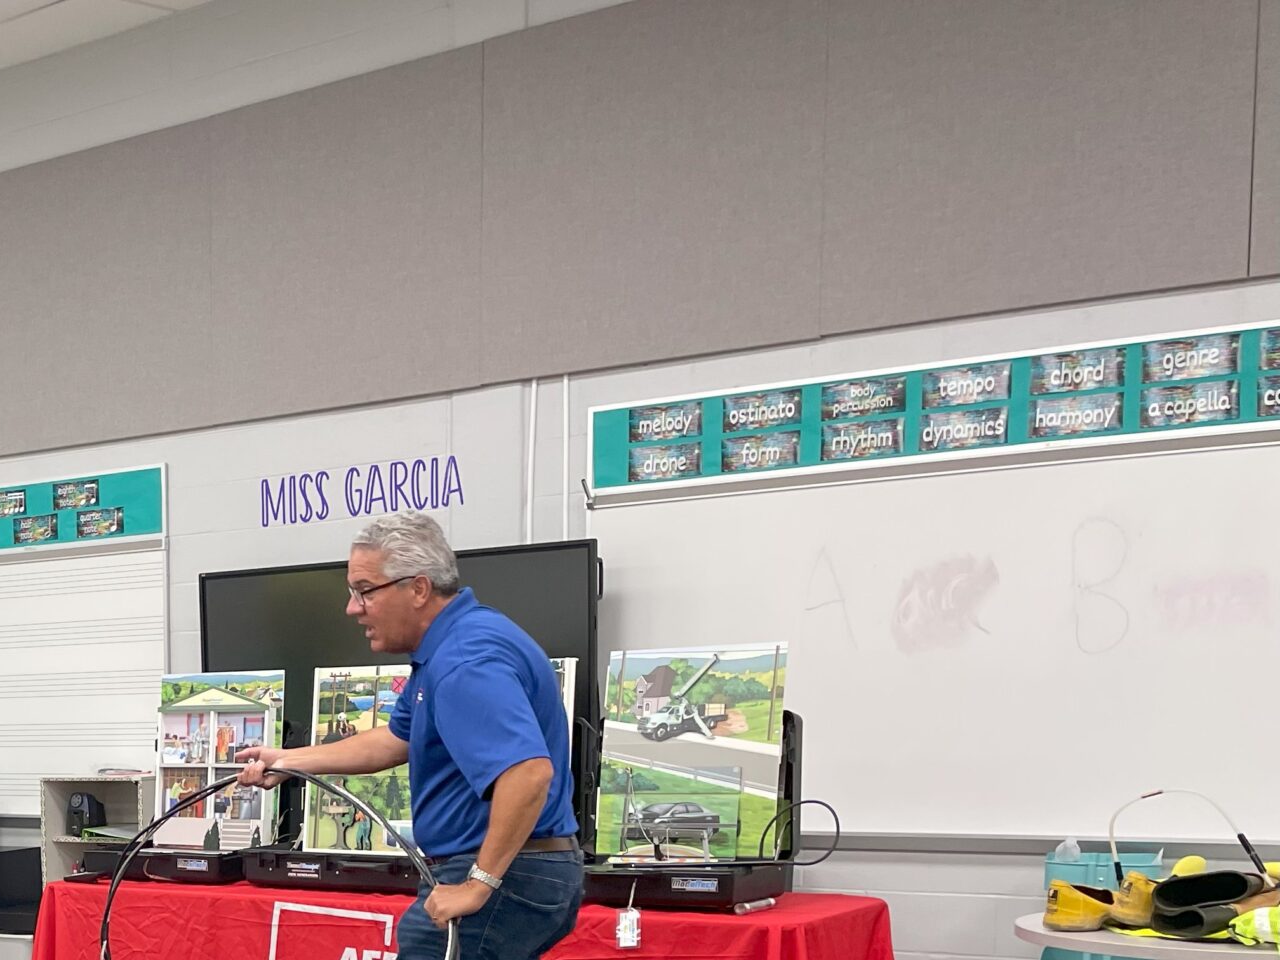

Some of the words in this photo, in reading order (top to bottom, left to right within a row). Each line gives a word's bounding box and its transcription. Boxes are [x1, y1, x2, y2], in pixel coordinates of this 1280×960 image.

[1050, 359, 1105, 386] chord
[1163, 348, 1220, 376] genre
[849, 384, 877, 400] body
[938, 376, 996, 401] tempo
[729, 401, 796, 425] ostinato
[832, 395, 893, 418] percussion
[1035, 405, 1116, 429] harmony
[1148, 402, 1161, 418] a
[1164, 390, 1232, 419] capella
[639, 411, 693, 436] melody
[922, 415, 1005, 448] dynamics
[741, 442, 780, 464] form
[832, 426, 893, 456] rhythm
[643, 454, 687, 474] drone
[260, 471, 330, 528] MISS
[344, 455, 465, 517] GARCIA
[1071, 516, 1130, 655] B
